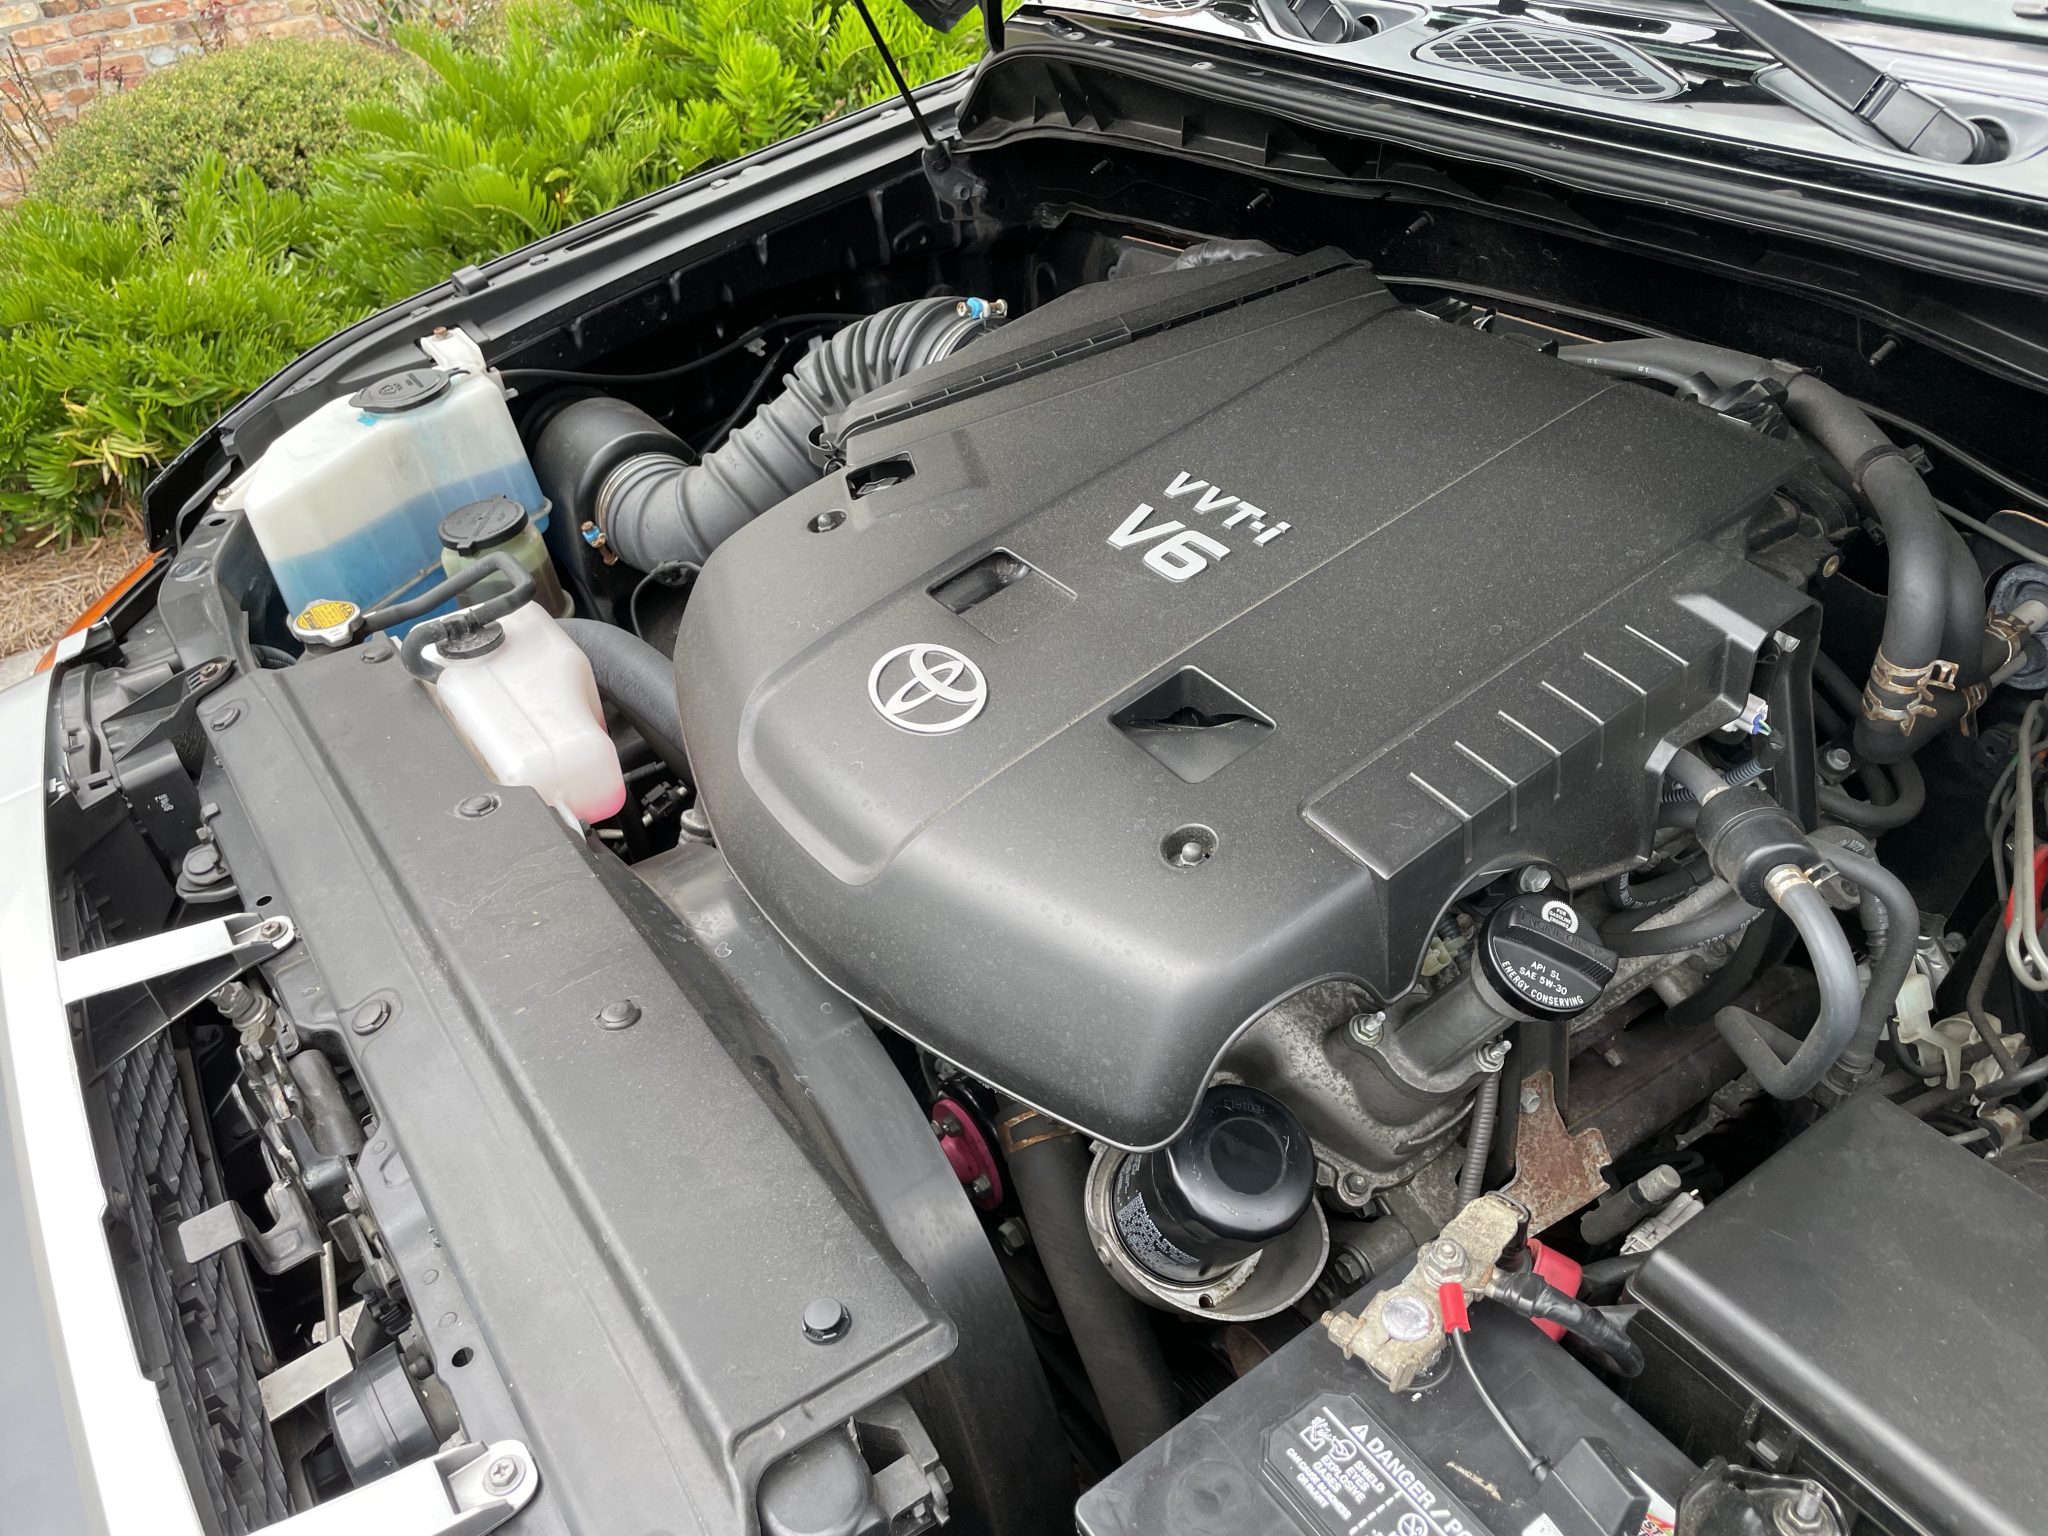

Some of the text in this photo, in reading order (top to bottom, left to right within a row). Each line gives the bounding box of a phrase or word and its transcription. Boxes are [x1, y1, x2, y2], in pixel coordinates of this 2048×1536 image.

[1163, 470, 1292, 548] VVT-i
[1106, 502, 1231, 583] V6
[1549, 910, 1571, 924] GASOLINE
[1501, 960, 1585, 1008] ENERGY CONSERVING
[1518, 966, 1568, 995] SAE 5W-30
[1531, 961, 1562, 981] API SL
[1286, 1447, 1304, 1466] CAN
[1366, 1436, 1437, 1510] DANGER
[1312, 1461, 1342, 1494] GASES
[1320, 1454, 1367, 1504] EXPLOSIVE
[1345, 1466, 1370, 1493] EYES
[1354, 1459, 1386, 1494] SHIELD
